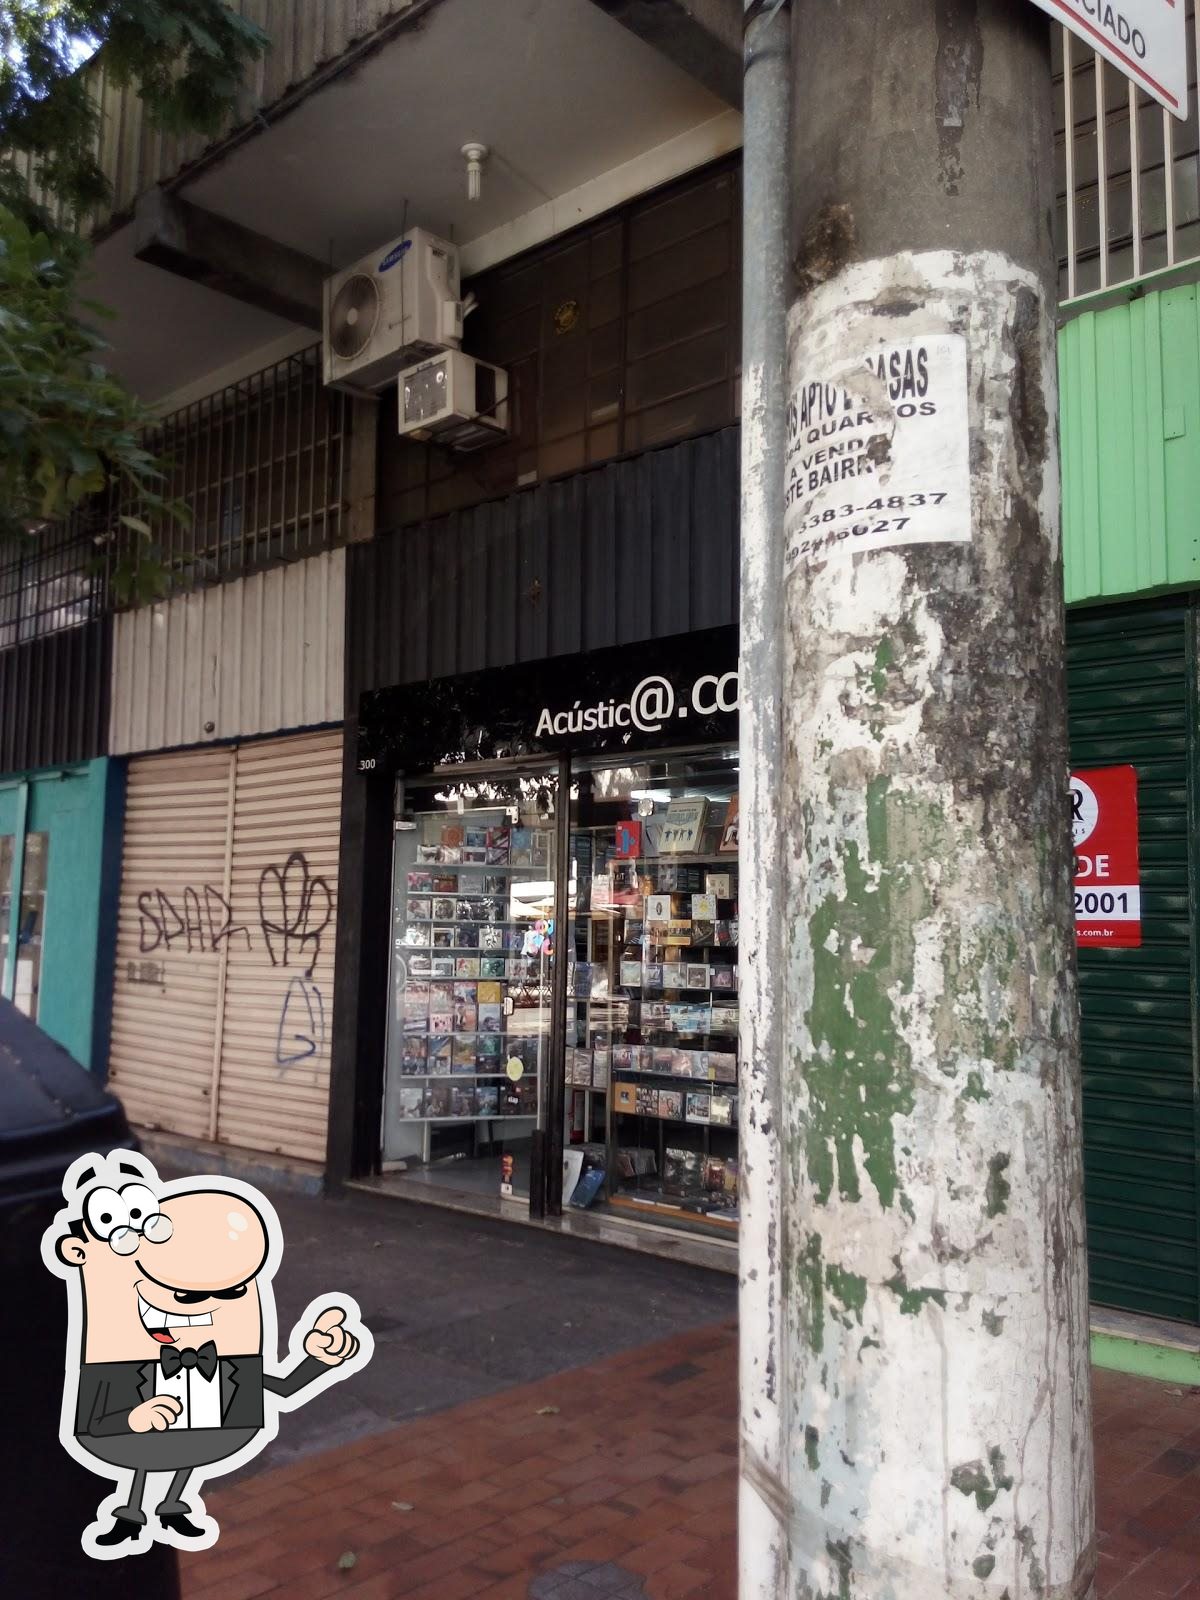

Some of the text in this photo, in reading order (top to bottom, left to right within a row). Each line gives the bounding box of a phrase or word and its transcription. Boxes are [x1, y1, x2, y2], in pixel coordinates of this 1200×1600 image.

[1074, 0, 1146, 59] CIADO
[865, 347, 928, 401] ASAS
[806, 401, 937, 444] QUAROS
[802, 438, 868, 470] VEND
[808, 454, 874, 492] BAIRR
[357, 758, 376, 770] 300
